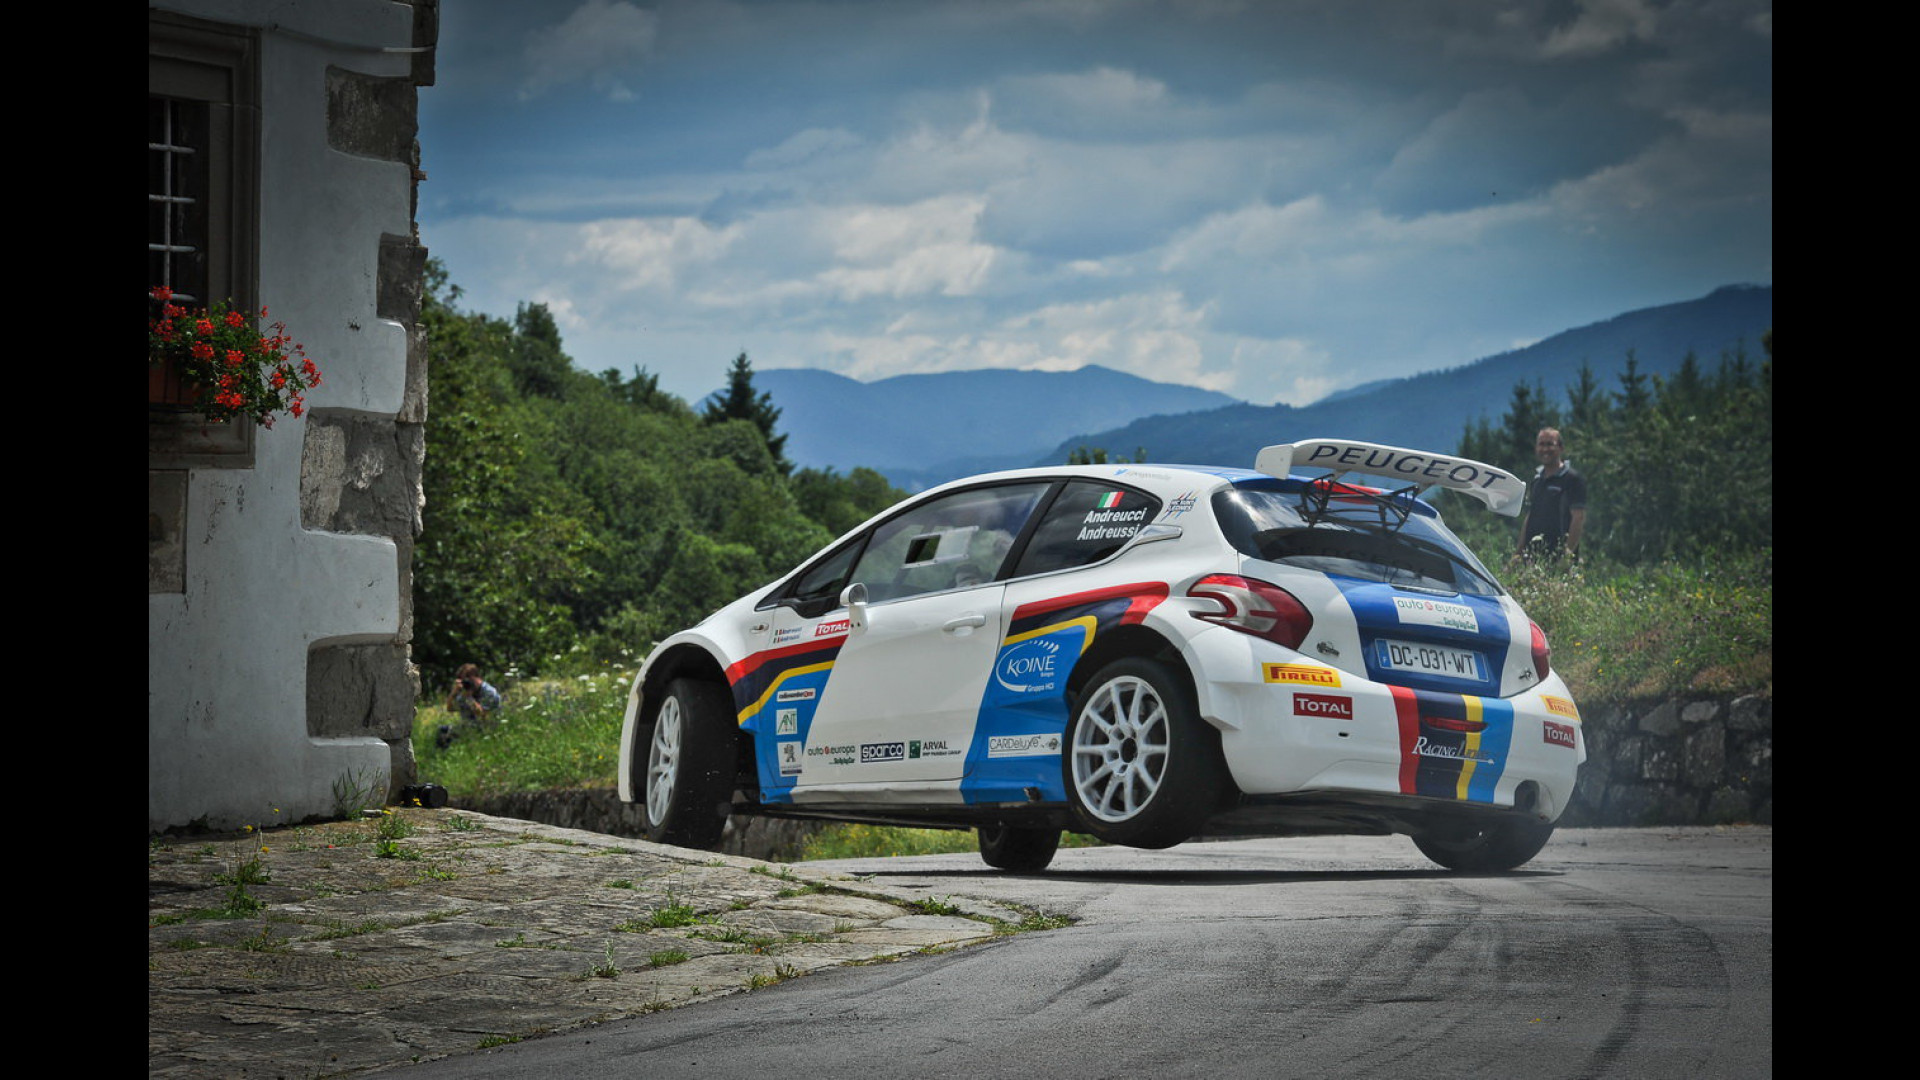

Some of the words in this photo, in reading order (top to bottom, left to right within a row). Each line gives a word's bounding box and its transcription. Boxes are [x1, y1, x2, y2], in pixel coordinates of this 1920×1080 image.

[1308, 445, 1506, 489] PEUGEOT
[1083, 507, 1147, 524] Andreucci
[1076, 524, 1140, 541] Andreussi
[1397, 600, 1424, 610] auto
[1435, 603, 1473, 619] europa
[816, 622, 848, 635] TOTAL
[1006, 654, 1056, 678] KOINE
[1389, 644, 1474, 675] DC-031-WT
[1269, 666, 1334, 683] PIRELLI
[1296, 698, 1351, 715] TOTAL
[1545, 725, 1574, 745] TOTAL
[807, 747, 823, 757] auto
[830, 745, 856, 757] europa
[862, 743, 904, 758] sparco
[923, 741, 949, 750] ARVAL
